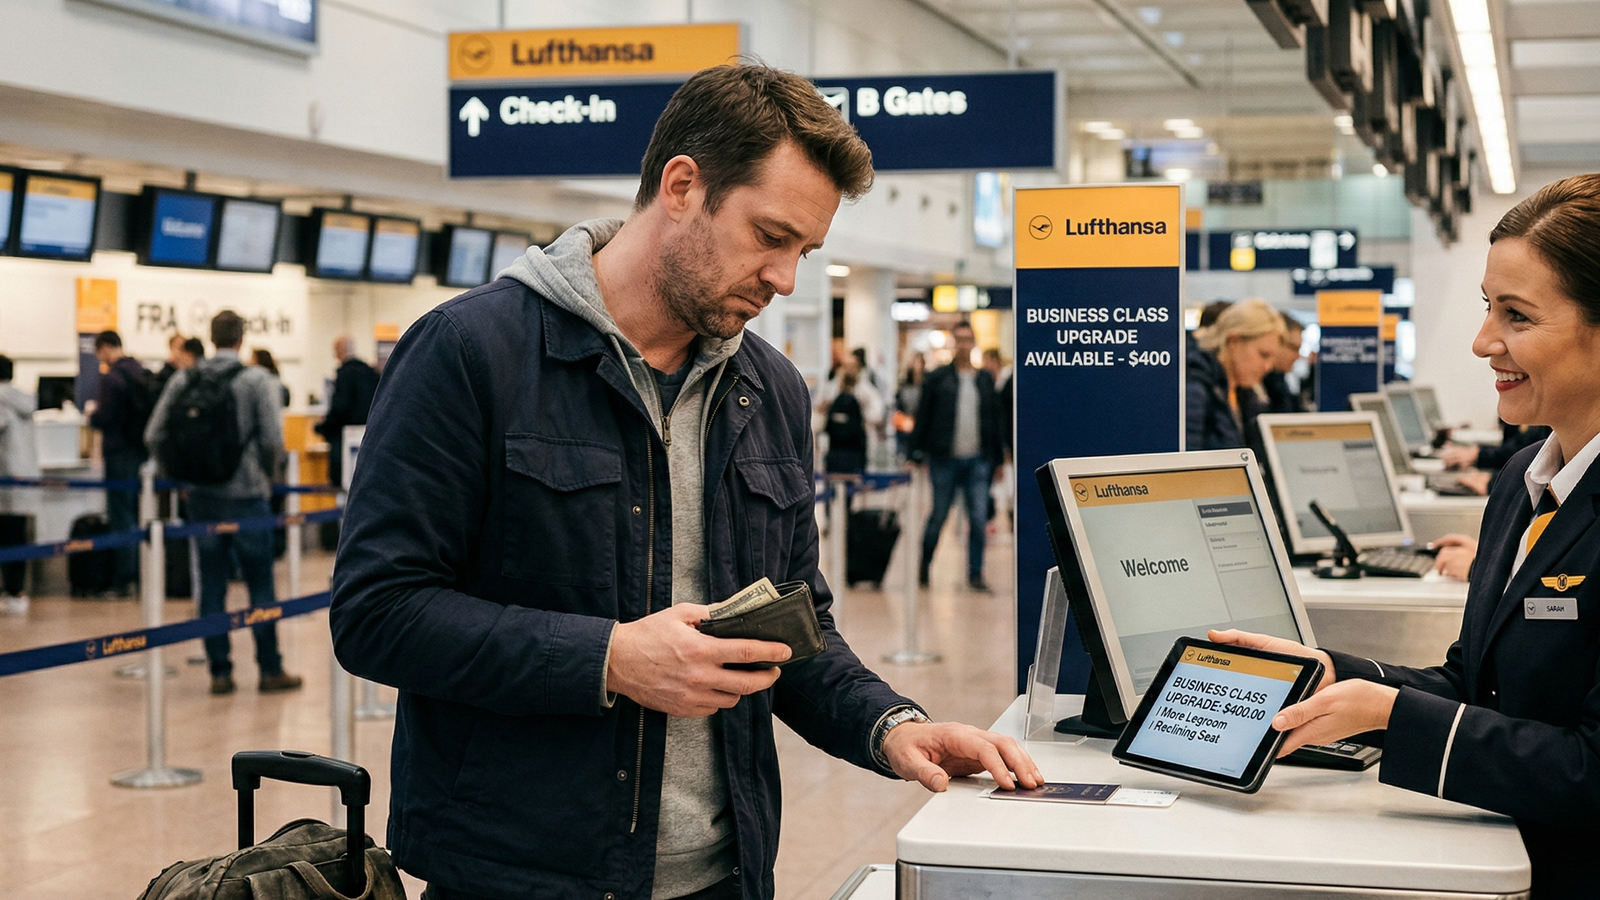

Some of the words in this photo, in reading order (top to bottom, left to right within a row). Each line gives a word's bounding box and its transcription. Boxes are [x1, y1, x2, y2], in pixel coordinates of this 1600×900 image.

[511, 39, 655, 66] Lufthansa
[856, 87, 880, 117] B
[883, 86, 968, 116] Gates
[1066, 218, 1167, 236] Lufthansa
[137, 304, 177, 331] FRA
[1026, 308, 1109, 323] BUSINESS
[1113, 307, 1169, 322] CLASS
[1056, 329, 1138, 345] UPGRADE
[1024, 351, 1114, 366] AVAILABLE
[1128, 350, 1171, 367] $400
[1094, 483, 1149, 499] Lufthansa
[1120, 557, 1189, 578] Welcome
[102, 634, 147, 655] Lufthansa
[1197, 653, 1230, 666] Lufthansa
[1172, 676, 1229, 697] BUSINESS
[1228, 687, 1268, 705] CLASS
[1165, 690, 1222, 713] UPGRADE:
[1222, 702, 1266, 722] $400.00
[1160, 706, 1186, 723] More
[1185, 711, 1228, 731] Legroom
[1153, 720, 1197, 741] Reclining
[1197, 730, 1221, 744] Seat
